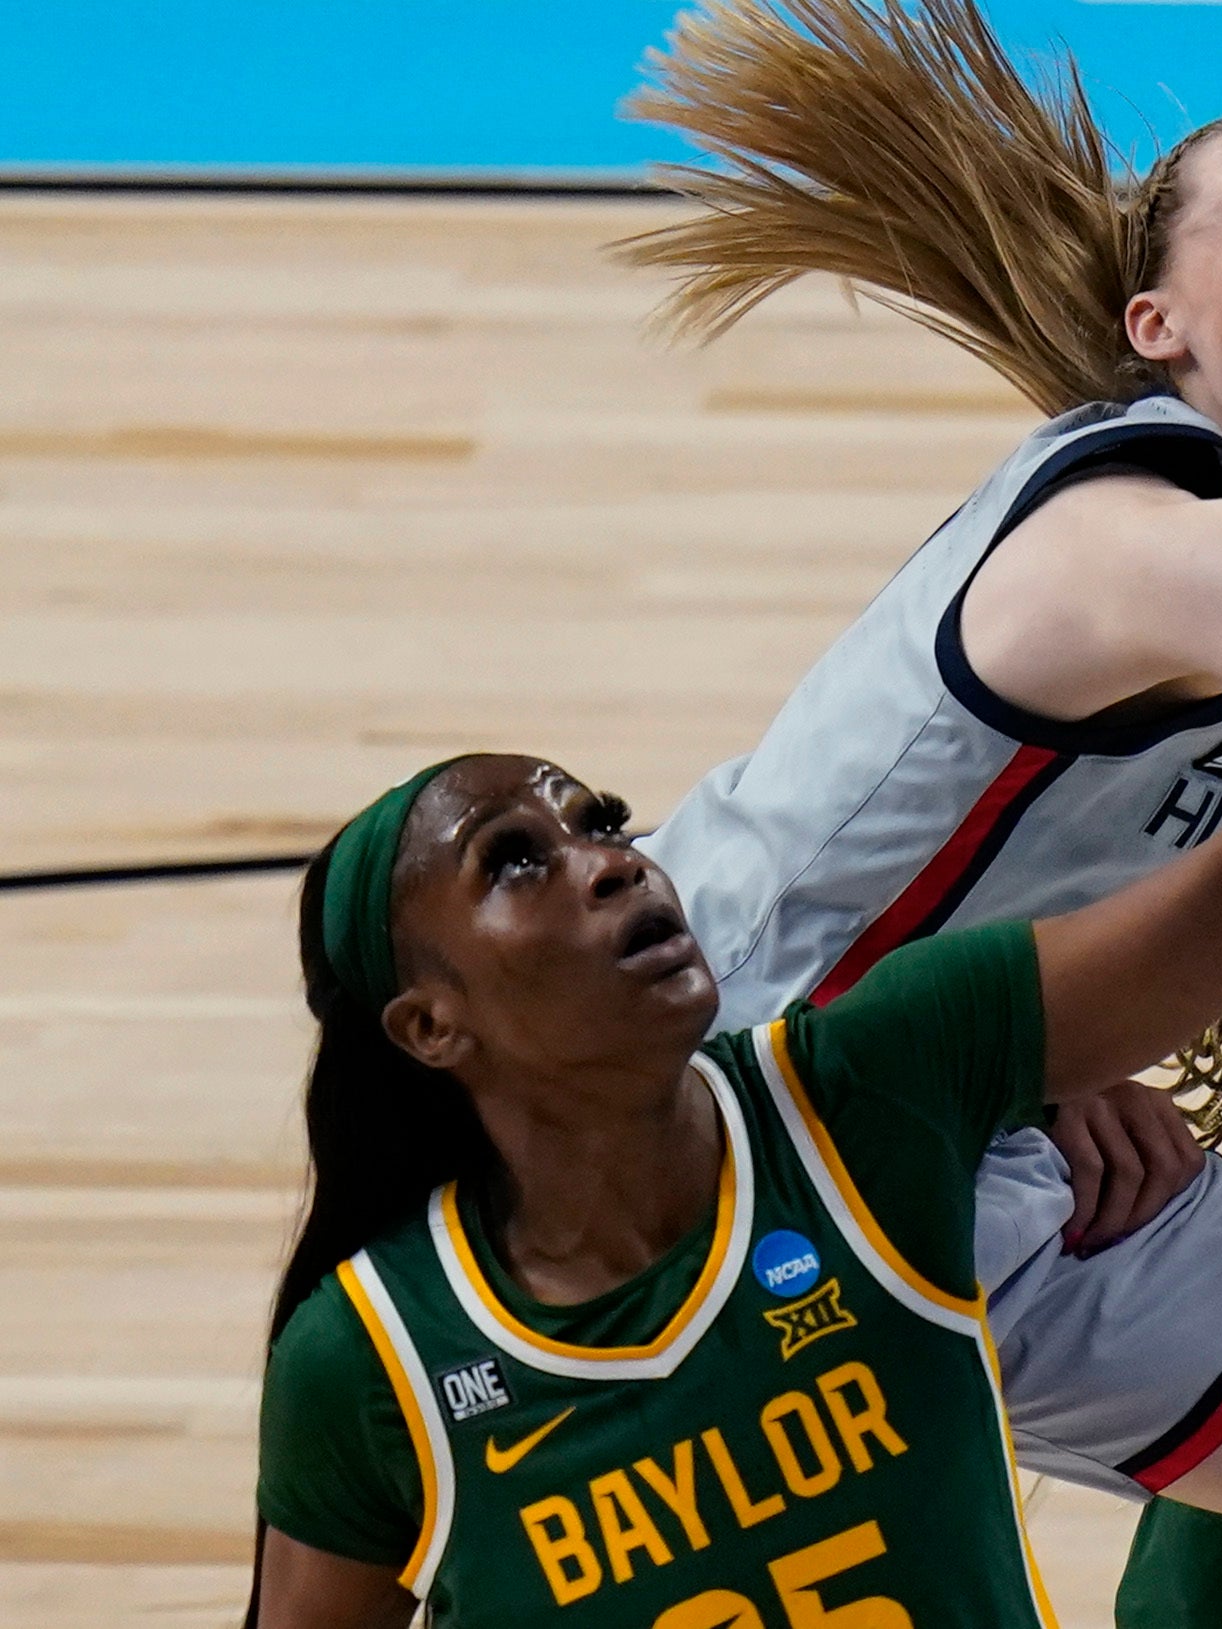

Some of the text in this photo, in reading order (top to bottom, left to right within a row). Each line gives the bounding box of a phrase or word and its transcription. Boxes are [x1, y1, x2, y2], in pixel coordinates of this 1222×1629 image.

[765, 1253, 820, 1288] NCAA
[442, 1360, 505, 1411] ONE
[518, 1361, 909, 1607] BAYLOR
